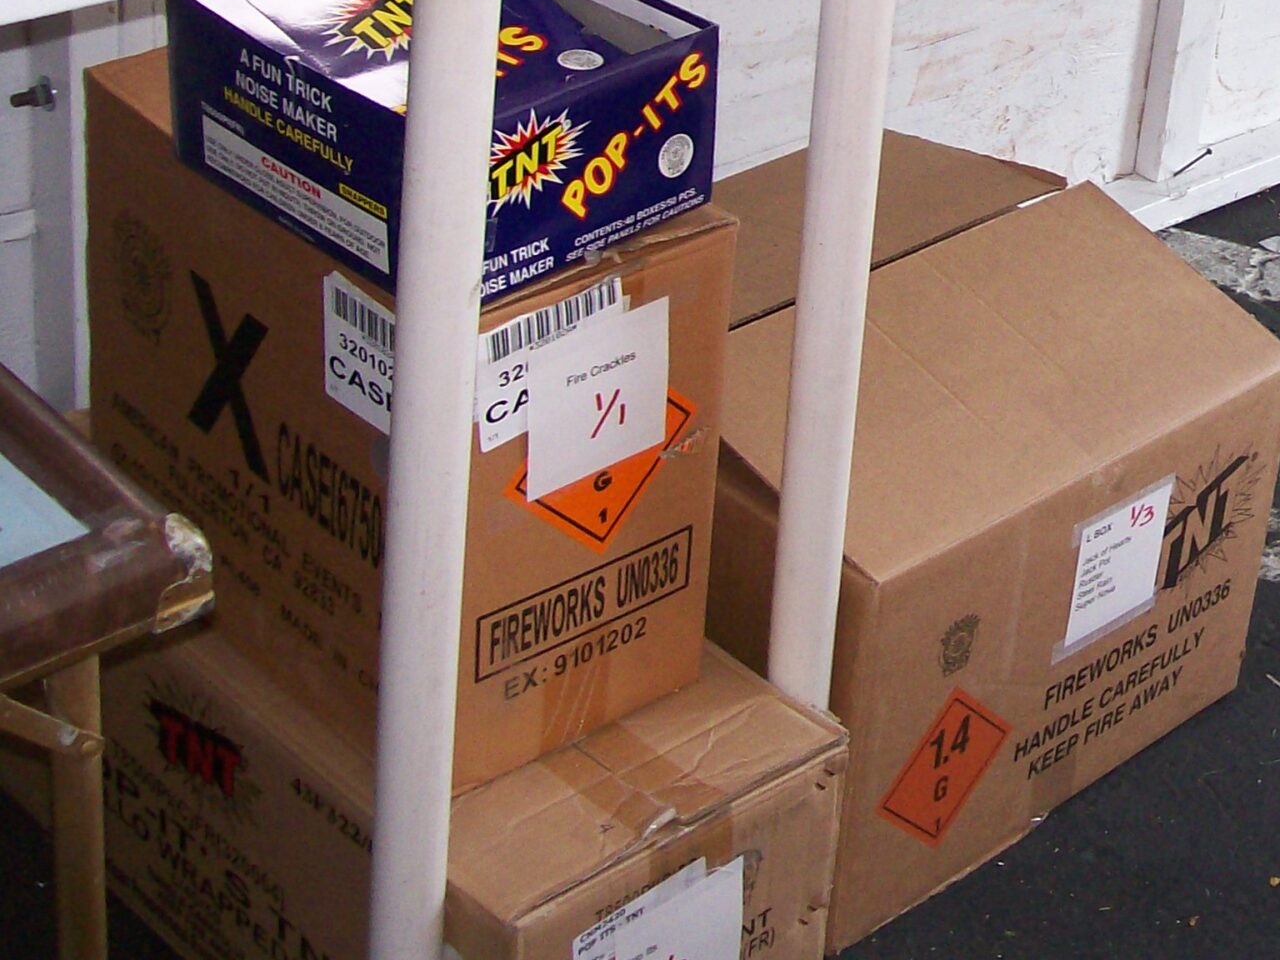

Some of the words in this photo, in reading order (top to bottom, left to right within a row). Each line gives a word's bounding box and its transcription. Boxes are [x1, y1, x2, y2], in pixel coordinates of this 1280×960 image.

[234, 70, 280, 108] NOISE
[282, 95, 338, 144] MAKER
[240, 48, 251, 68] A
[252, 54, 284, 83] FUN
[285, 70, 334, 115] TRICK
[223, 86, 275, 129] HANDLE
[275, 111, 355, 173] CAREFULLY
[492, 125, 564, 199] TNT
[560, 50, 710, 220] POP-ITS
[260, 155, 323, 200] CAUTION
[508, 236, 551, 266] TRICK
[565, 249, 585, 263] SEE
[607, 222, 642, 244] PANELS
[642, 213, 662, 229] FOR
[661, 194, 705, 220] CAUTIONS
[508, 255, 555, 289] MAKER
[566, 371, 588, 388] Fire
[590, 351, 637, 378] Crackles
[593, 470, 613, 493] G
[1130, 502, 1156, 529] 1/3
[598, 507, 608, 526] 1
[1093, 521, 1114, 541] BOX
[487, 574, 607, 667] FIREWORKS
[616, 542, 681, 609] UN0336
[503, 664, 549, 702] EX:
[552, 614, 648, 678] 9101202
[1043, 624, 1158, 711] FIREWORKS
[1166, 577, 1232, 636] UN0336
[1012, 695, 1095, 763] HANDLE
[1099, 627, 1207, 711] CAREFULLY
[1026, 734, 1080, 781] KEEP
[1083, 706, 1125, 747] FIRE
[1129, 665, 1185, 720] AWAY
[158, 711, 242, 800] TNT
[929, 714, 972, 771] 1.4
[932, 775, 949, 803] G
